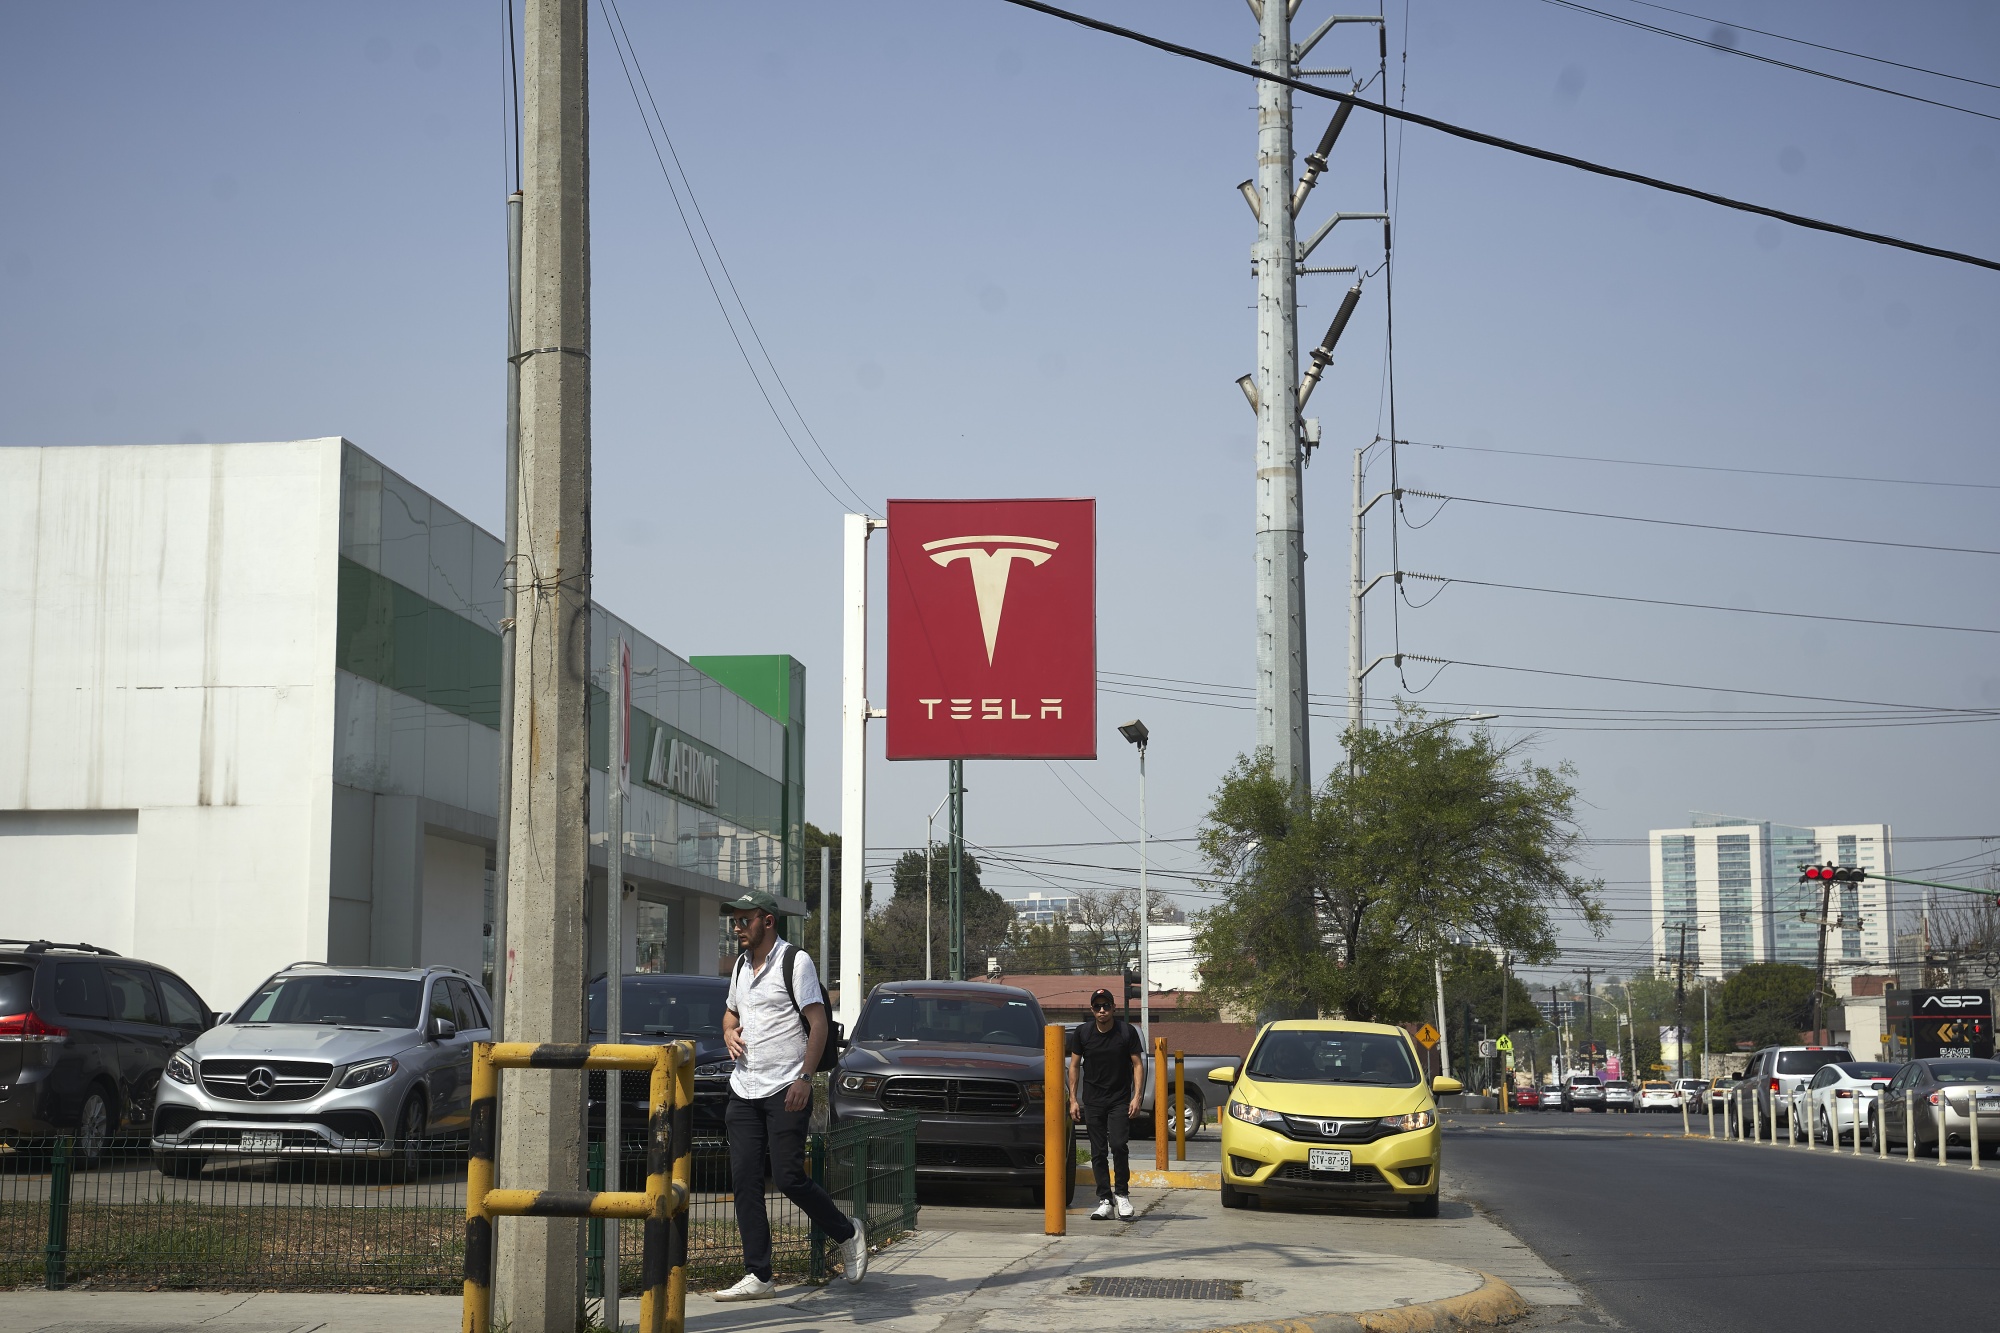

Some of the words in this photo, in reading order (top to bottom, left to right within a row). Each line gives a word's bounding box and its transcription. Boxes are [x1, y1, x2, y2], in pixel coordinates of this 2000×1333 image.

[918, 698, 1063, 720] TESLA
[667, 738, 720, 808] AFIRME
[1921, 995, 1983, 1008] ASP
[1311, 1155, 1349, 1166] STV-87-55
